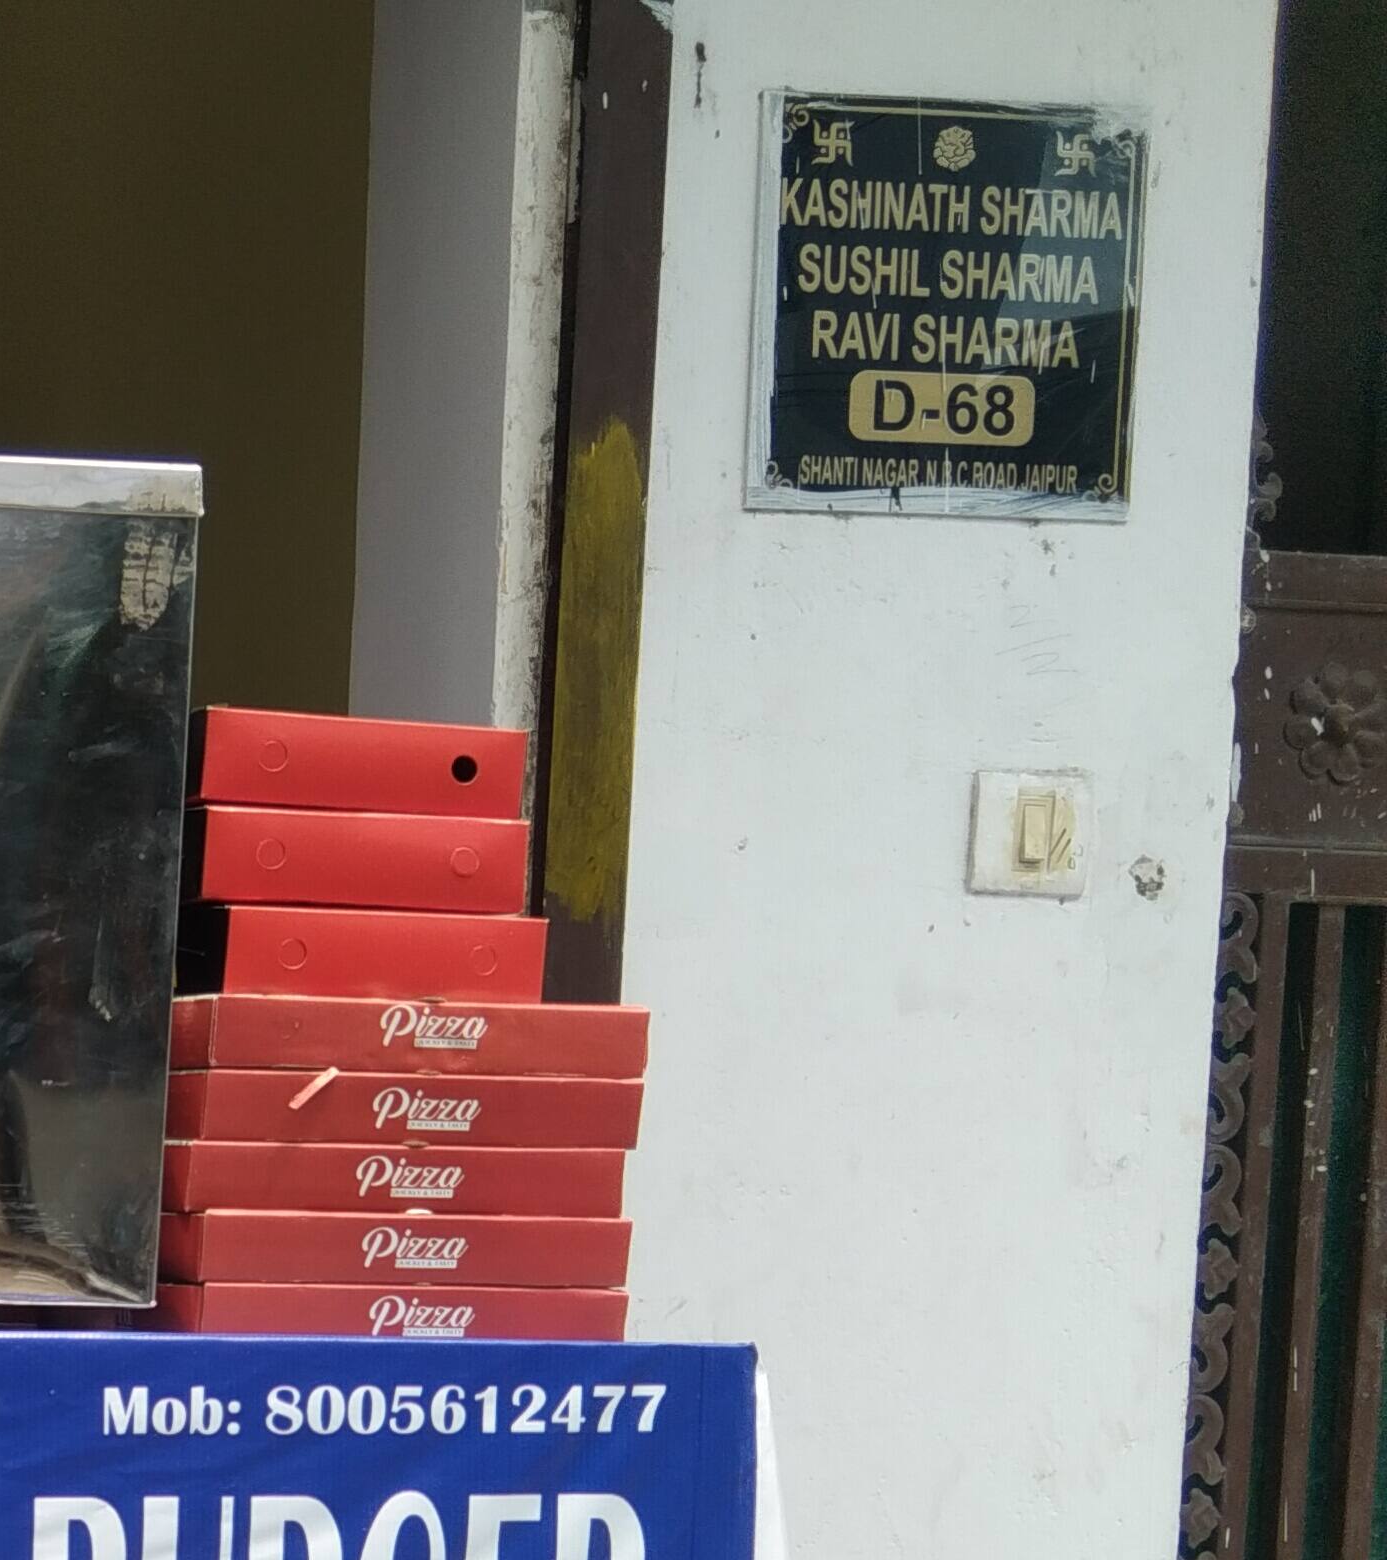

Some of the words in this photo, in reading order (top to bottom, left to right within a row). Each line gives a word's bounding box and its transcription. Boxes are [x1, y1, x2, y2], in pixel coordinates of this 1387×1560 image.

[781, 177, 970, 232] KASHINATH
[980, 184, 1122, 241] SHARMA
[798, 243, 930, 298] SUSHIL
[941, 249, 1098, 305] SHARMA
[812, 309, 900, 361] RAVI
[911, 313, 1080, 369] SHARMA
[873, 378, 1015, 437] D-68
[799, 454, 858, 486] SHANTI
[380, 1004, 488, 1047] Pizza
[373, 1087, 481, 1129] Pizza
[356, 1155, 464, 1197] Pizza
[362, 1226, 468, 1268] Pizza
[369, 1295, 475, 1336] Pizza
[103, 1385, 241, 1436] Mob:
[264, 1384, 667, 1435] 8005612477
